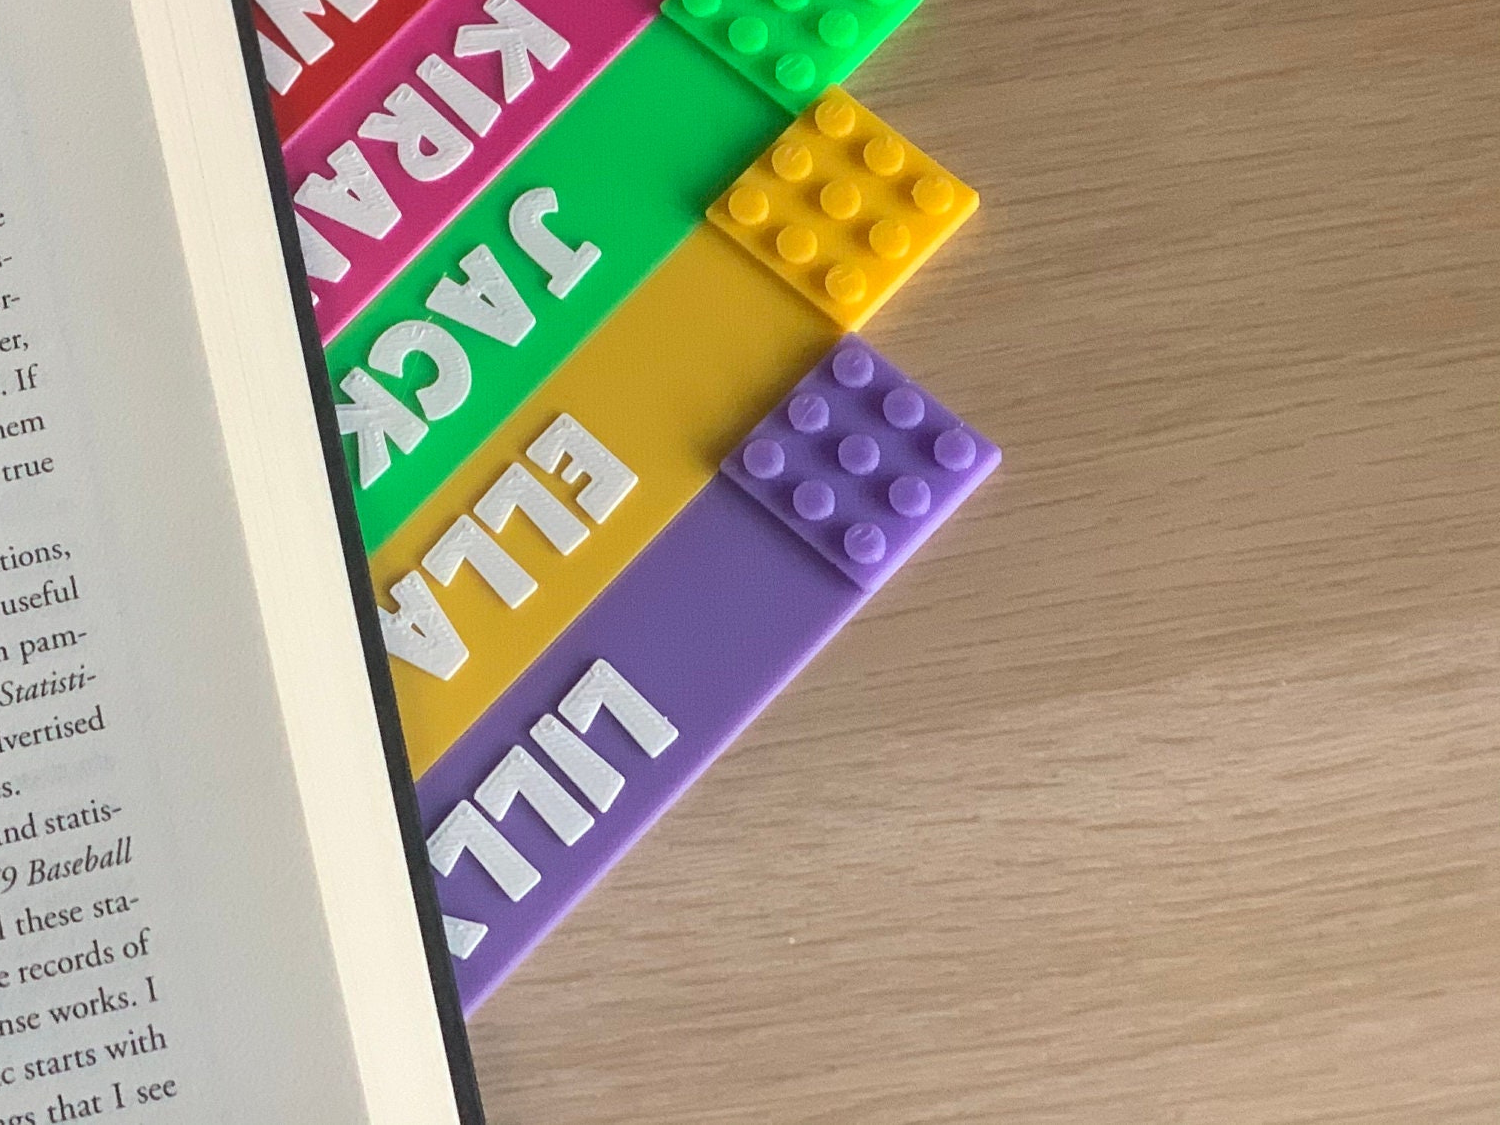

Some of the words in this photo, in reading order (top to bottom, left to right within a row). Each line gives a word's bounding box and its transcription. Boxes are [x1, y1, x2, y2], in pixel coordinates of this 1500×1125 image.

[335, 187, 602, 490] JACK
[377, 412, 639, 681] ELLA
[15, 906, 83, 935] these
[426, 658, 679, 960] LILL
